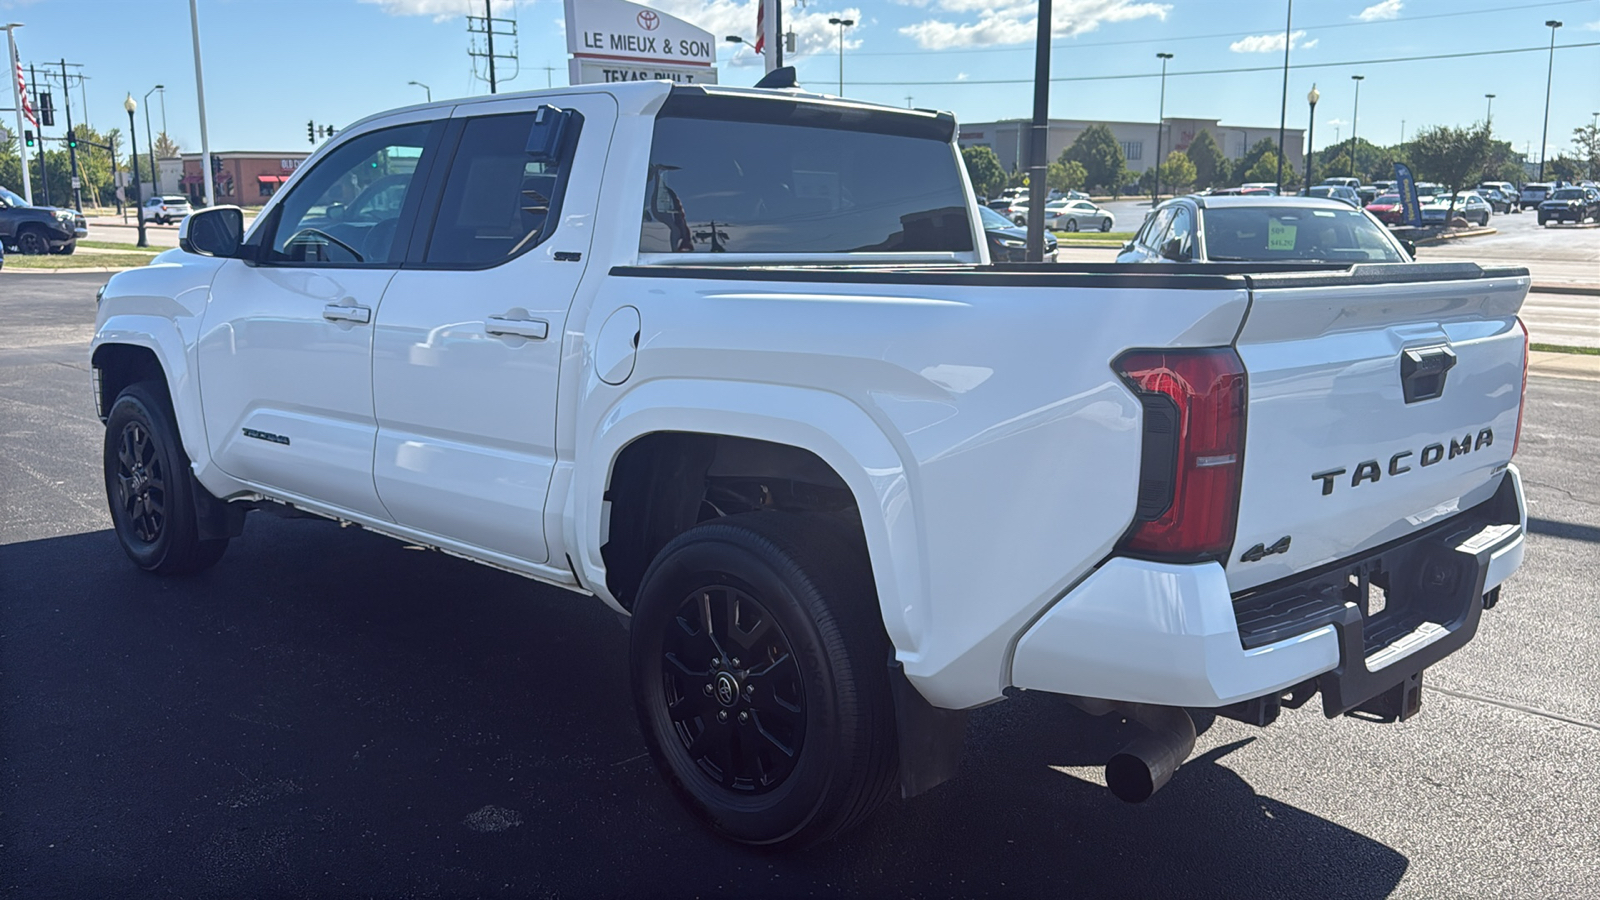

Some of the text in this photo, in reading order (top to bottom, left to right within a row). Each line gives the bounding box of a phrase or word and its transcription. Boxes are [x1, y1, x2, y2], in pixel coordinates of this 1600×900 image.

[584, 31, 710, 58] LE MIEUX & SON
[602, 69, 647, 83] TEXAS
[1311, 426, 1494, 496] TACOMA
